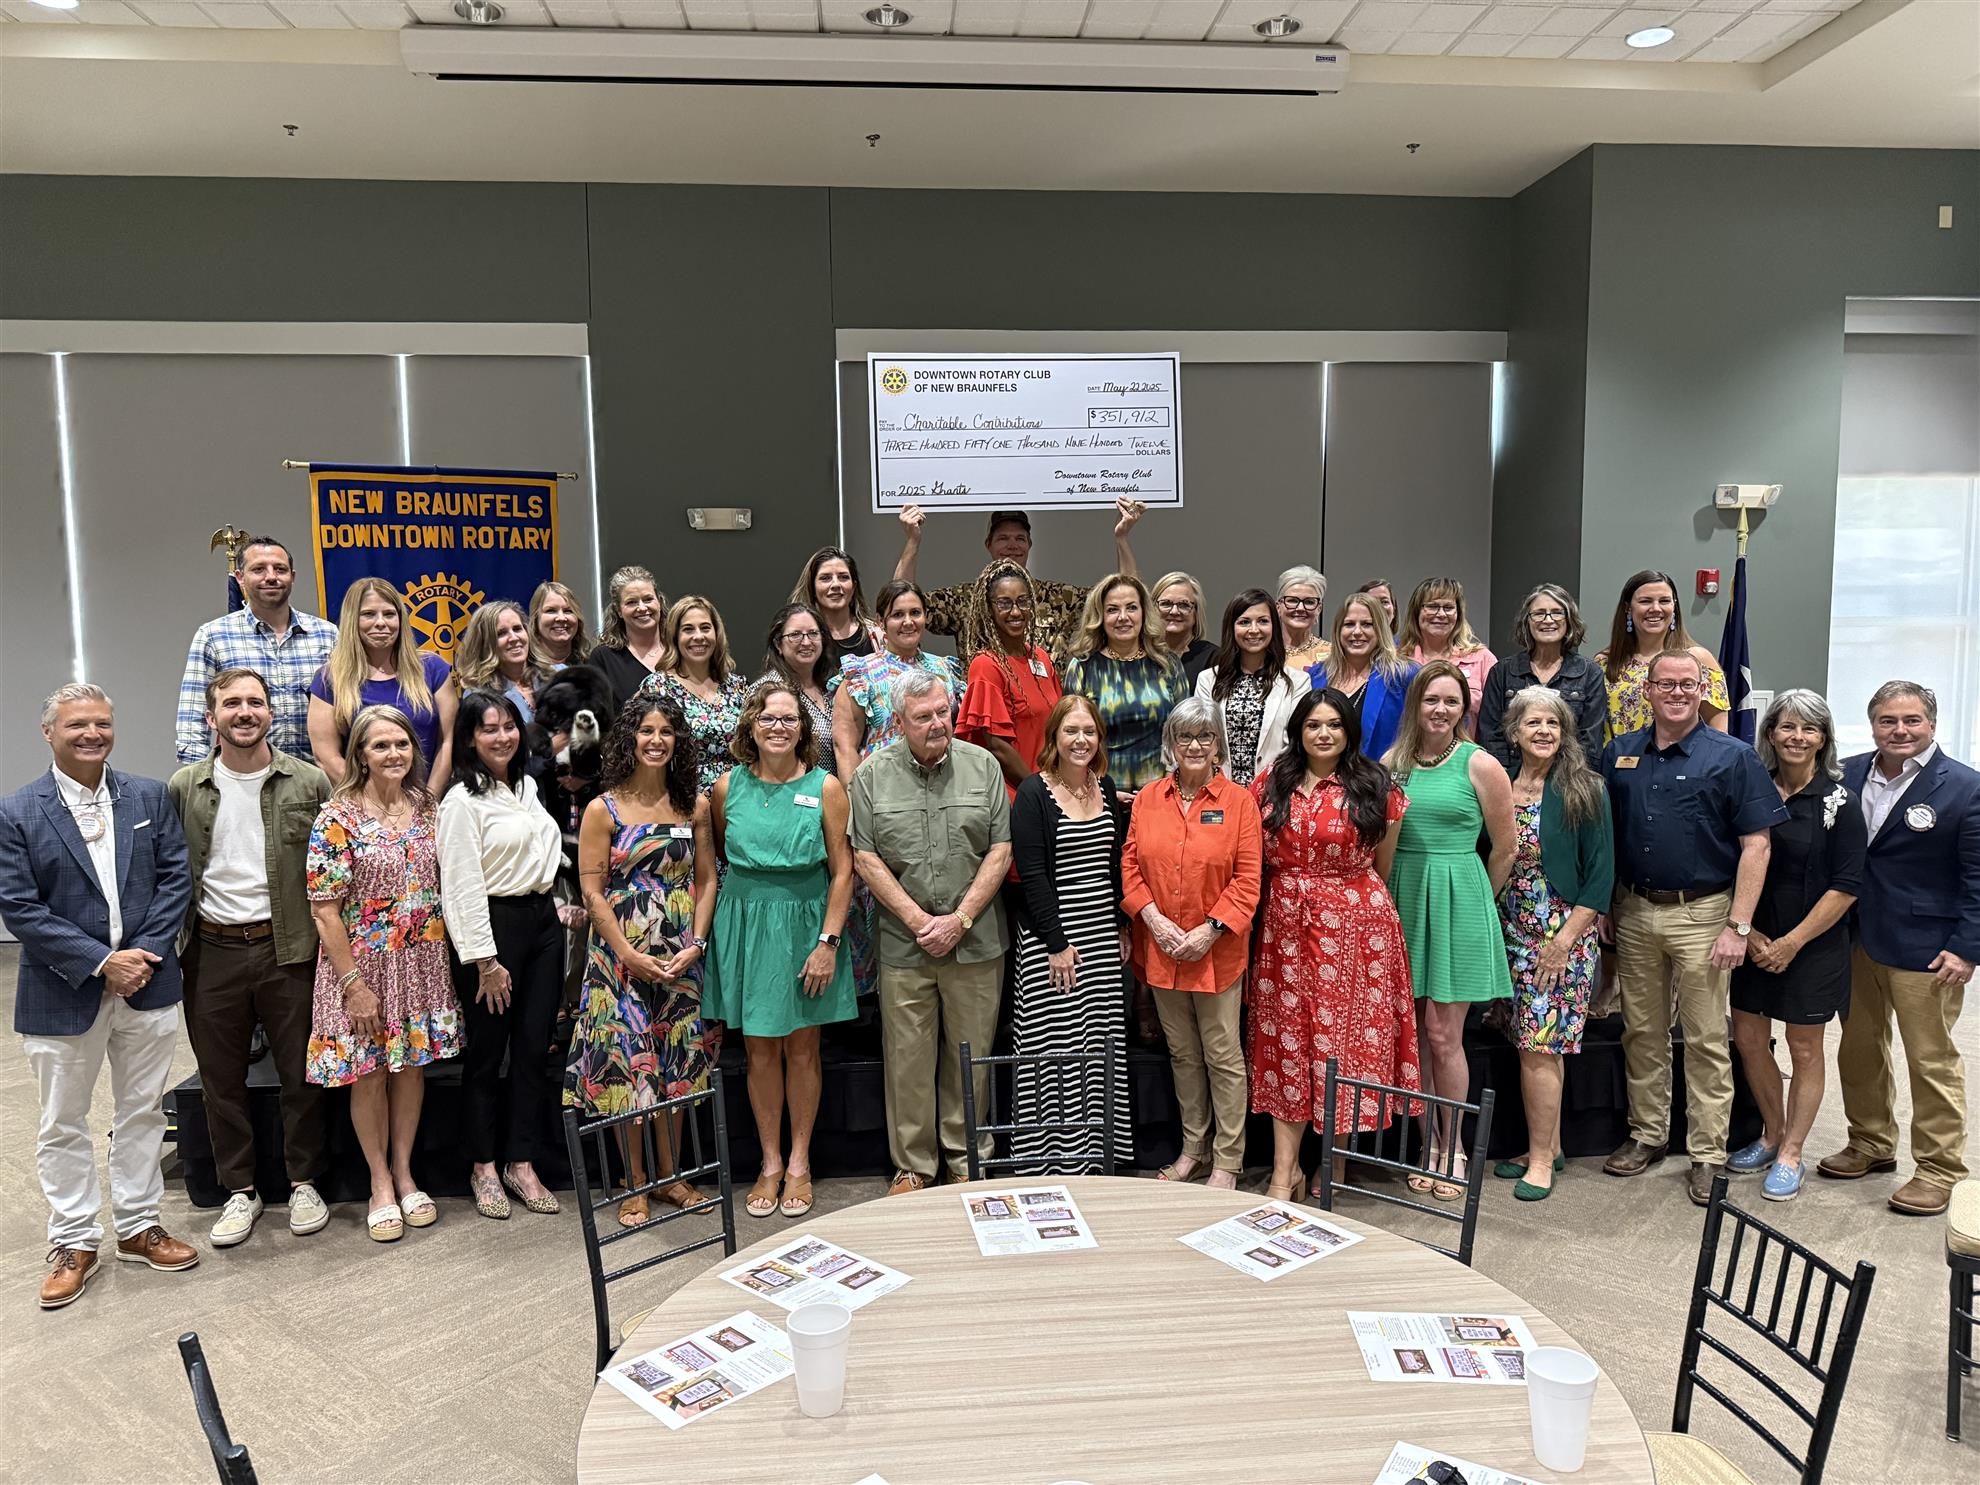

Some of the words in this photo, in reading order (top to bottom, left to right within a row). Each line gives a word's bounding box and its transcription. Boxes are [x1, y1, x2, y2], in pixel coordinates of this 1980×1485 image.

[914, 370, 977, 380] DOWNTOWN
[979, 370, 1021, 379] ROTARY
[1023, 370, 1051, 379] CLUB
[914, 383, 929, 393] OF
[931, 383, 954, 392] NEW
[957, 383, 1018, 392] BRAUNFELS
[1103, 382, 1128, 397] May
[904, 413, 967, 431] Charitable
[973, 413, 1043, 429] Contributions
[882, 438, 918, 452] THREE
[964, 437, 994, 451] FIFTY
[993, 440, 1013, 450] ONE
[1054, 470, 1097, 479] Downtown
[1100, 470, 1129, 480] Rotary
[1131, 469, 1152, 479] Club
[898, 485, 926, 496] 2025
[931, 480, 971, 495] Grants
[1066, 485, 1075, 494] of
[1077, 483, 1097, 493] New
[1100, 483, 1140, 494] Braunfels
[329, 489, 384, 514] NEW
[395, 490, 544, 519] BRAUNFELS
[320, 524, 454, 549] DOWNTOWN
[462, 526, 551, 550] ROTARY
[416, 586, 464, 602] ROTARY
